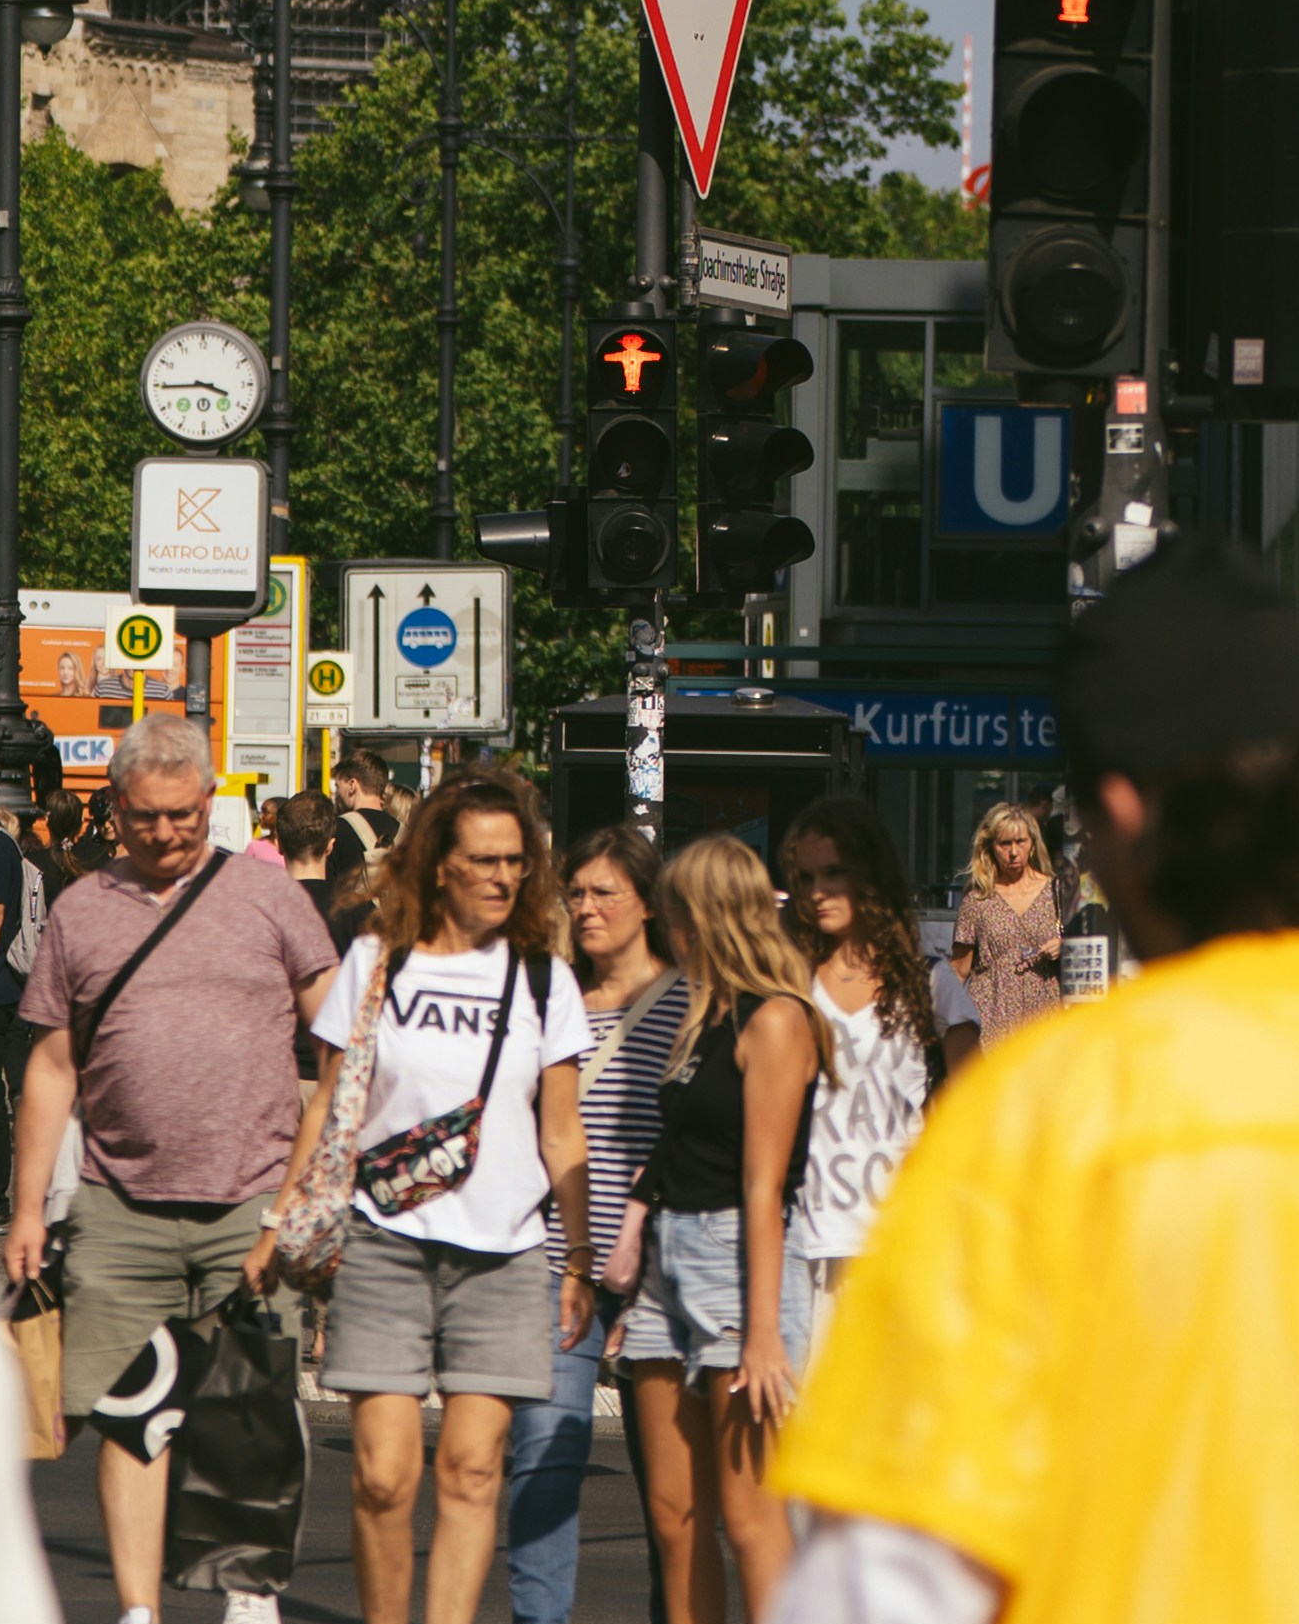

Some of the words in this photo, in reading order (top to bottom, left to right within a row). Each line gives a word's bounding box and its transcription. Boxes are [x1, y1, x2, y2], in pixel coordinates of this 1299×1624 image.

[760, 259, 786, 301] Straße
[974, 416, 1062, 525] U
[148, 544, 209, 561] KATRO
[212, 546, 250, 561] BAU
[129, 626, 151, 650] H
[319, 669, 336, 688] H
[854, 701, 1057, 748] Kurfürste
[389, 989, 510, 1038] VANS
